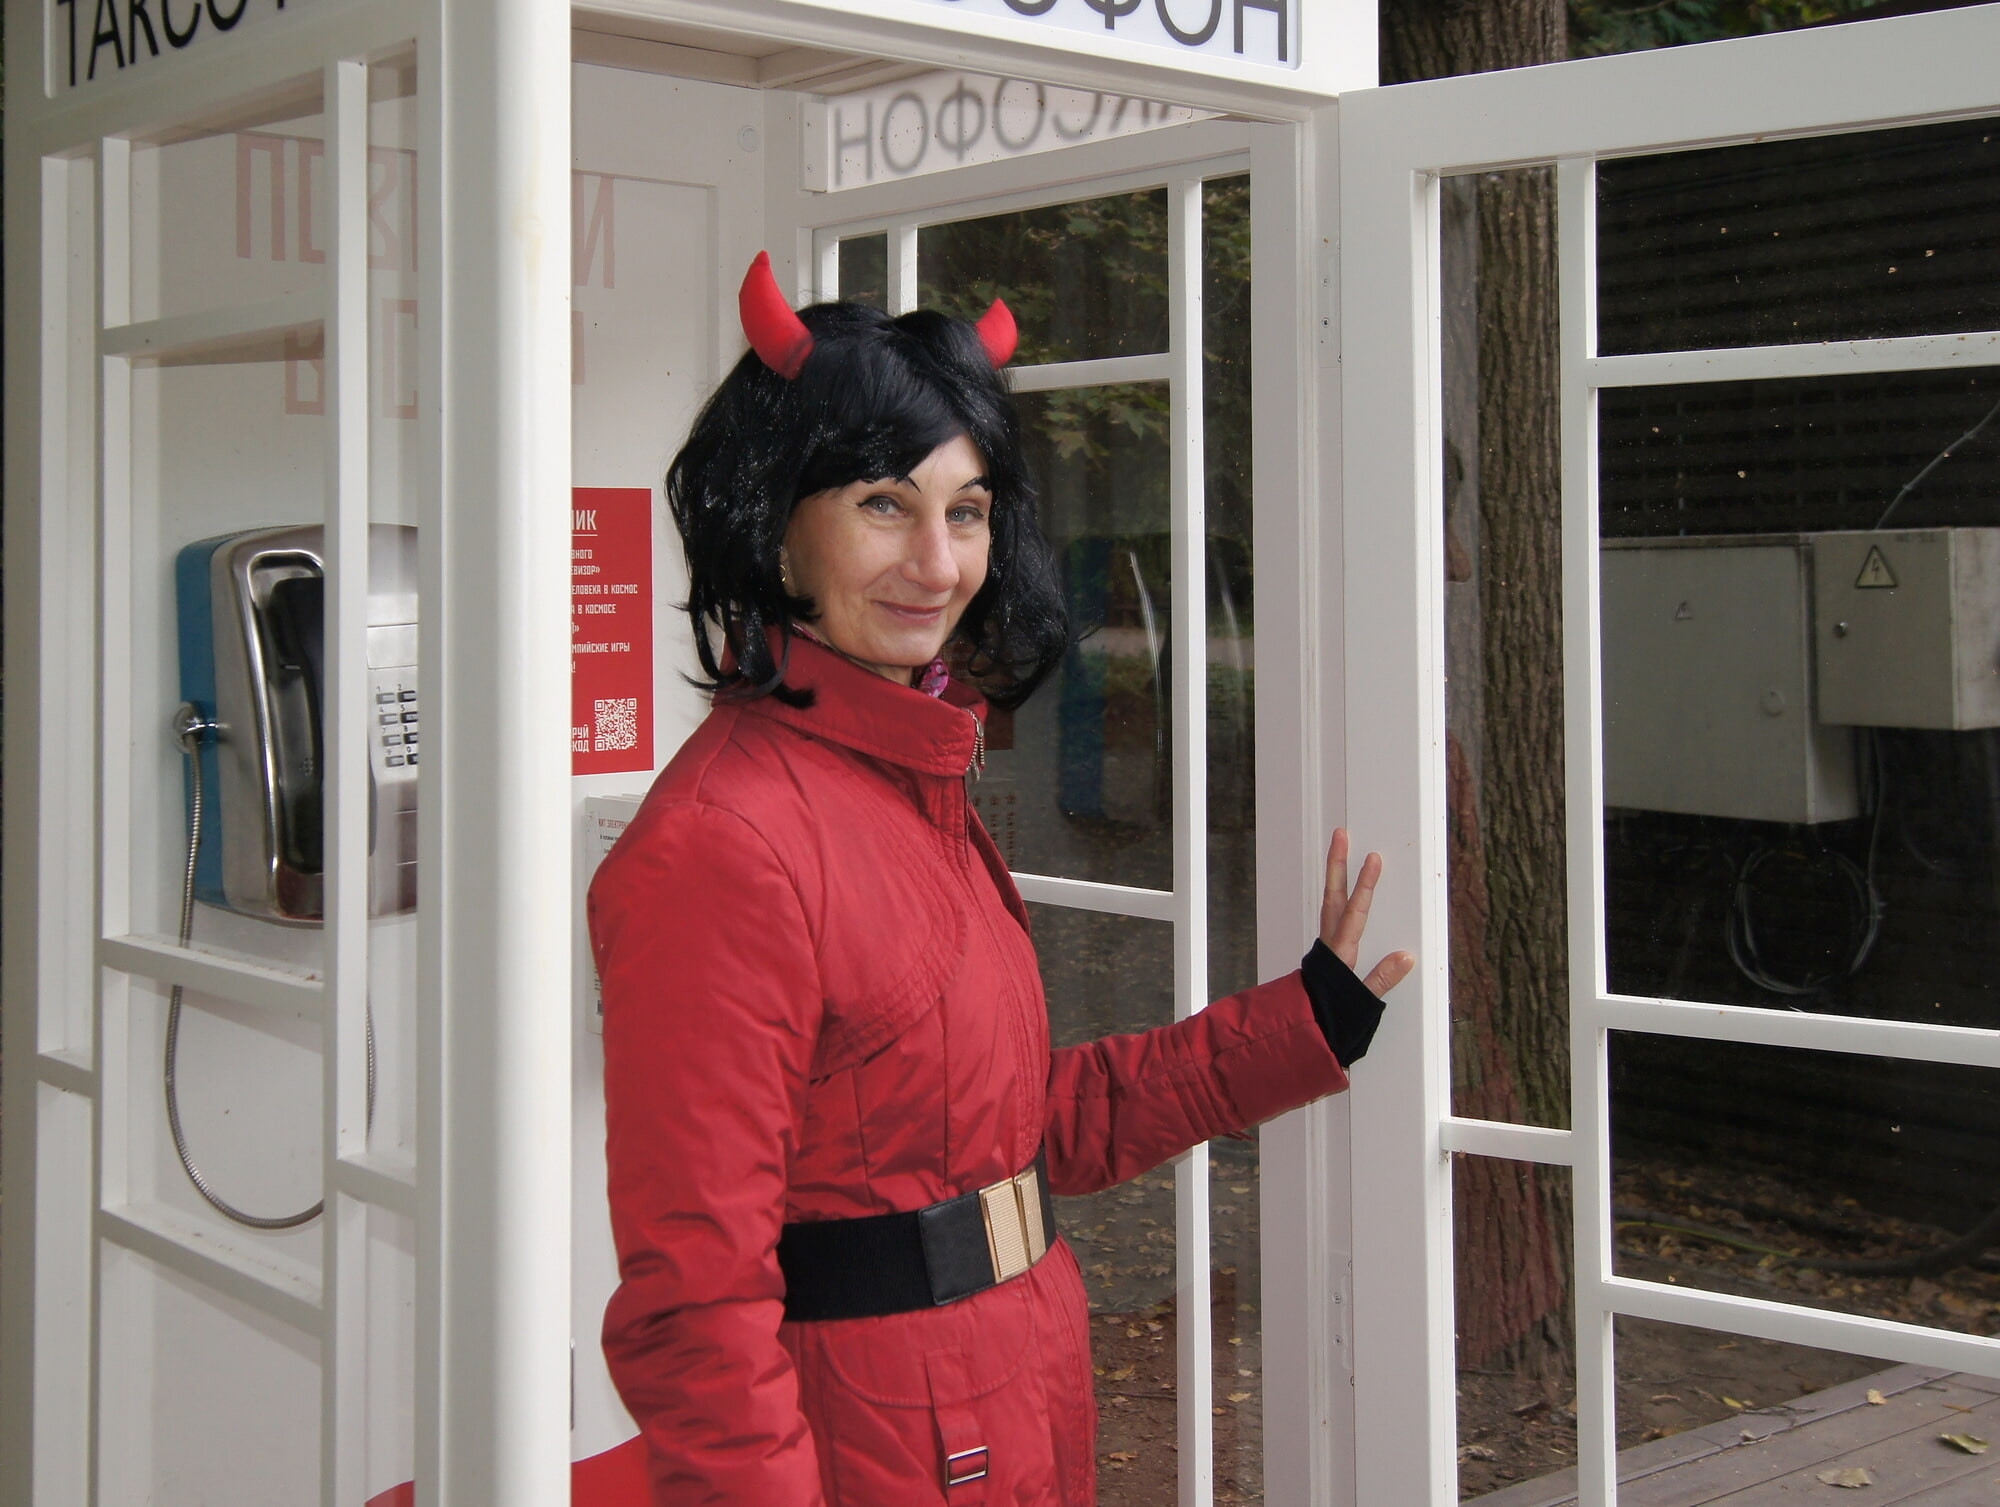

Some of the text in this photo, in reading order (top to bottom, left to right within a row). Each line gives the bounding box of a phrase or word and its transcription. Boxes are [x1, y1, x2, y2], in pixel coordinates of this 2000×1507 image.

[57, 0, 284, 87] ТАКС
[603, 584, 609, 594] В
[611, 584, 638, 594] КОСМОС
[577, 604, 583, 614] В
[585, 603, 617, 614] КОСМОСЕ
[611, 642, 630, 652] ИГРЫ
[572, 723, 589, 738] РУЙ
[572, 739, 590, 753] КОД
